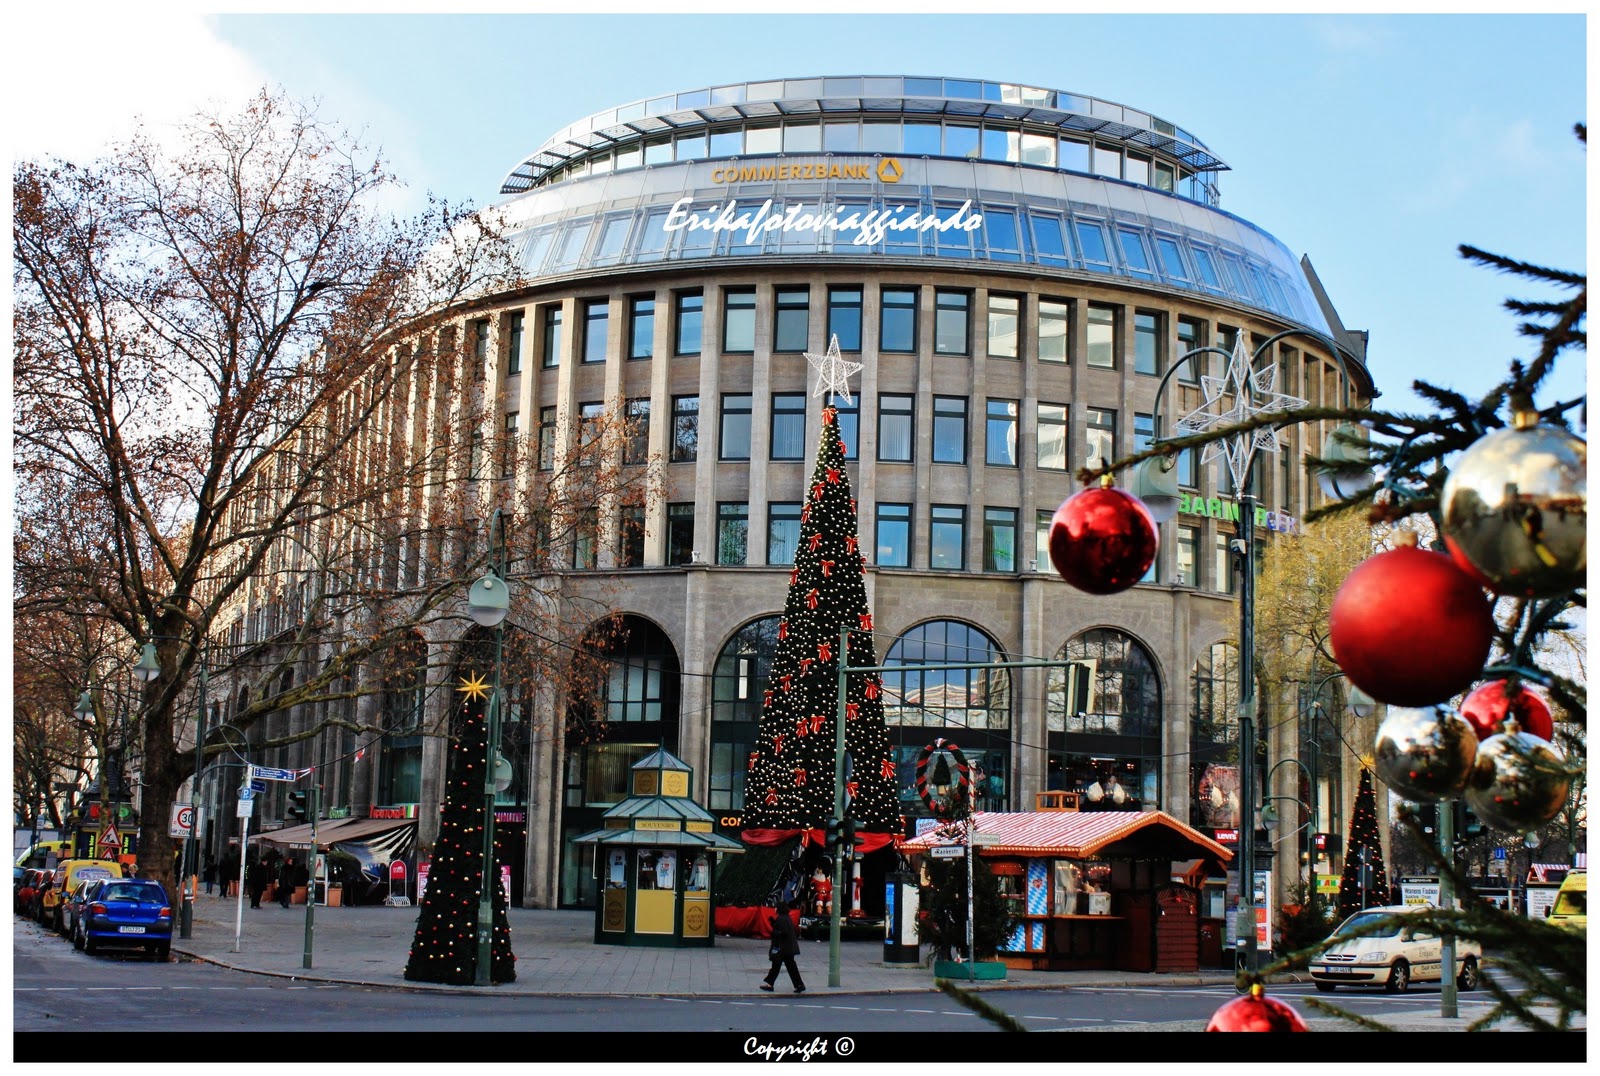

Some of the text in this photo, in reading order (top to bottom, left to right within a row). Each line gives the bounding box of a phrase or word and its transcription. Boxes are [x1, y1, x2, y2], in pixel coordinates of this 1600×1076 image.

[711, 163, 870, 184] COMMERZBANK
[369, 804, 406, 819] TRATTORIA
[1422, 887, 1438, 895] Fashion
